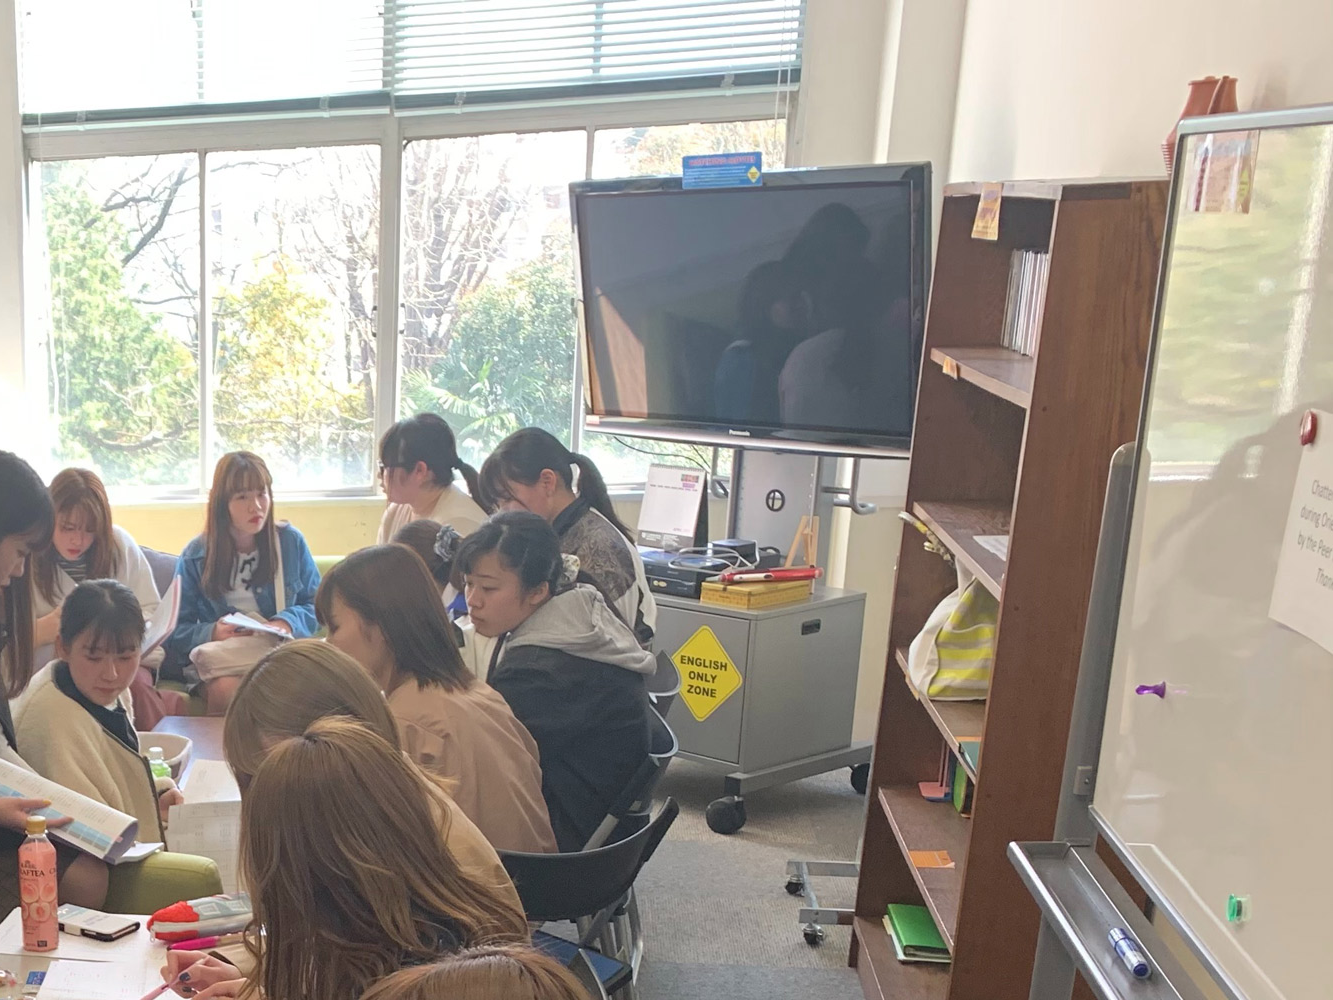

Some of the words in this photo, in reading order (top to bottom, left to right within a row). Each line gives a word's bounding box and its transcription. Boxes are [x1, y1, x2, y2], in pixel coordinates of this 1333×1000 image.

[1300, 504, 1321, 529] during
[1297, 530, 1306, 551] by
[1306, 533, 1317, 552] the
[680, 655, 728, 671] ENGLISH
[688, 671, 717, 684] ONLY
[687, 684, 717, 698] ZONE
